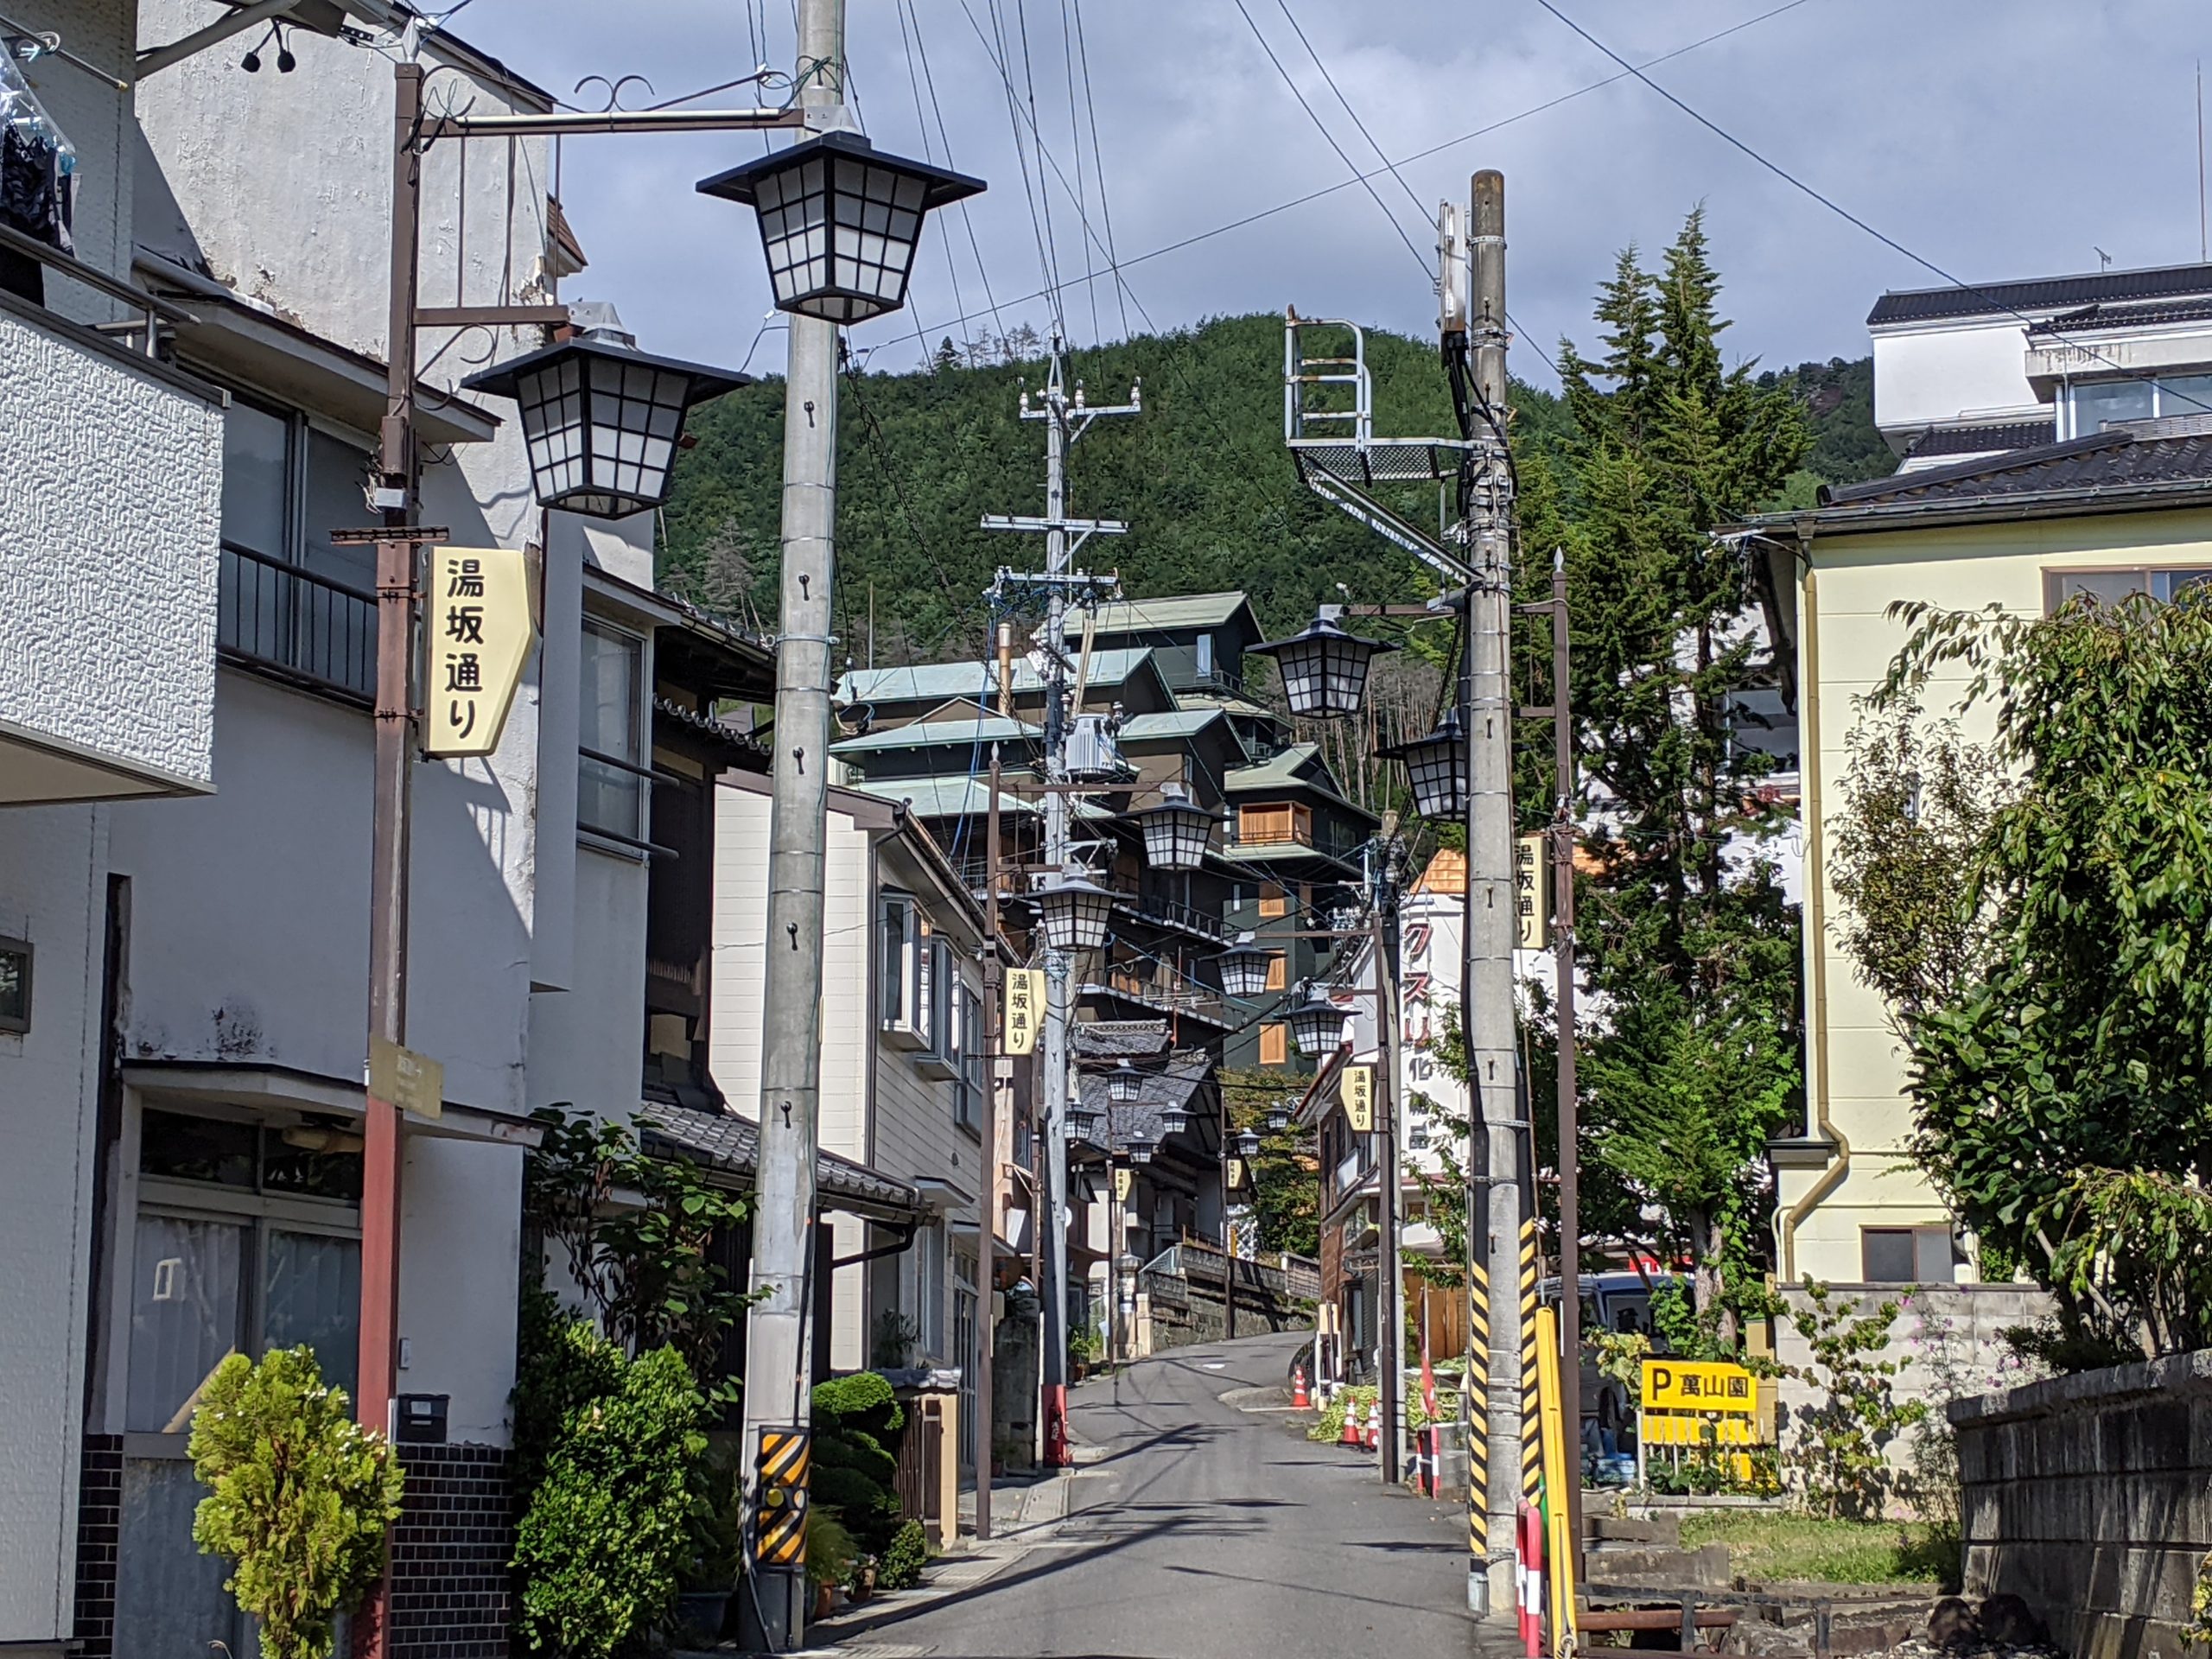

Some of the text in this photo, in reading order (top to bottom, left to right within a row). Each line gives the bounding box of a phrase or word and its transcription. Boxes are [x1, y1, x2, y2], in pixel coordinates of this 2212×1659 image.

[445, 558, 485, 739] 湯坂通り
[1514, 844, 1535, 942] 湯坂通り
[1011, 973, 1028, 1049] 湯坂通り
[1403, 923, 1431, 1049] クスリ
[1354, 1071, 1366, 1128] 湯坂通り
[1652, 1367, 1748, 1401] P 萬山園
